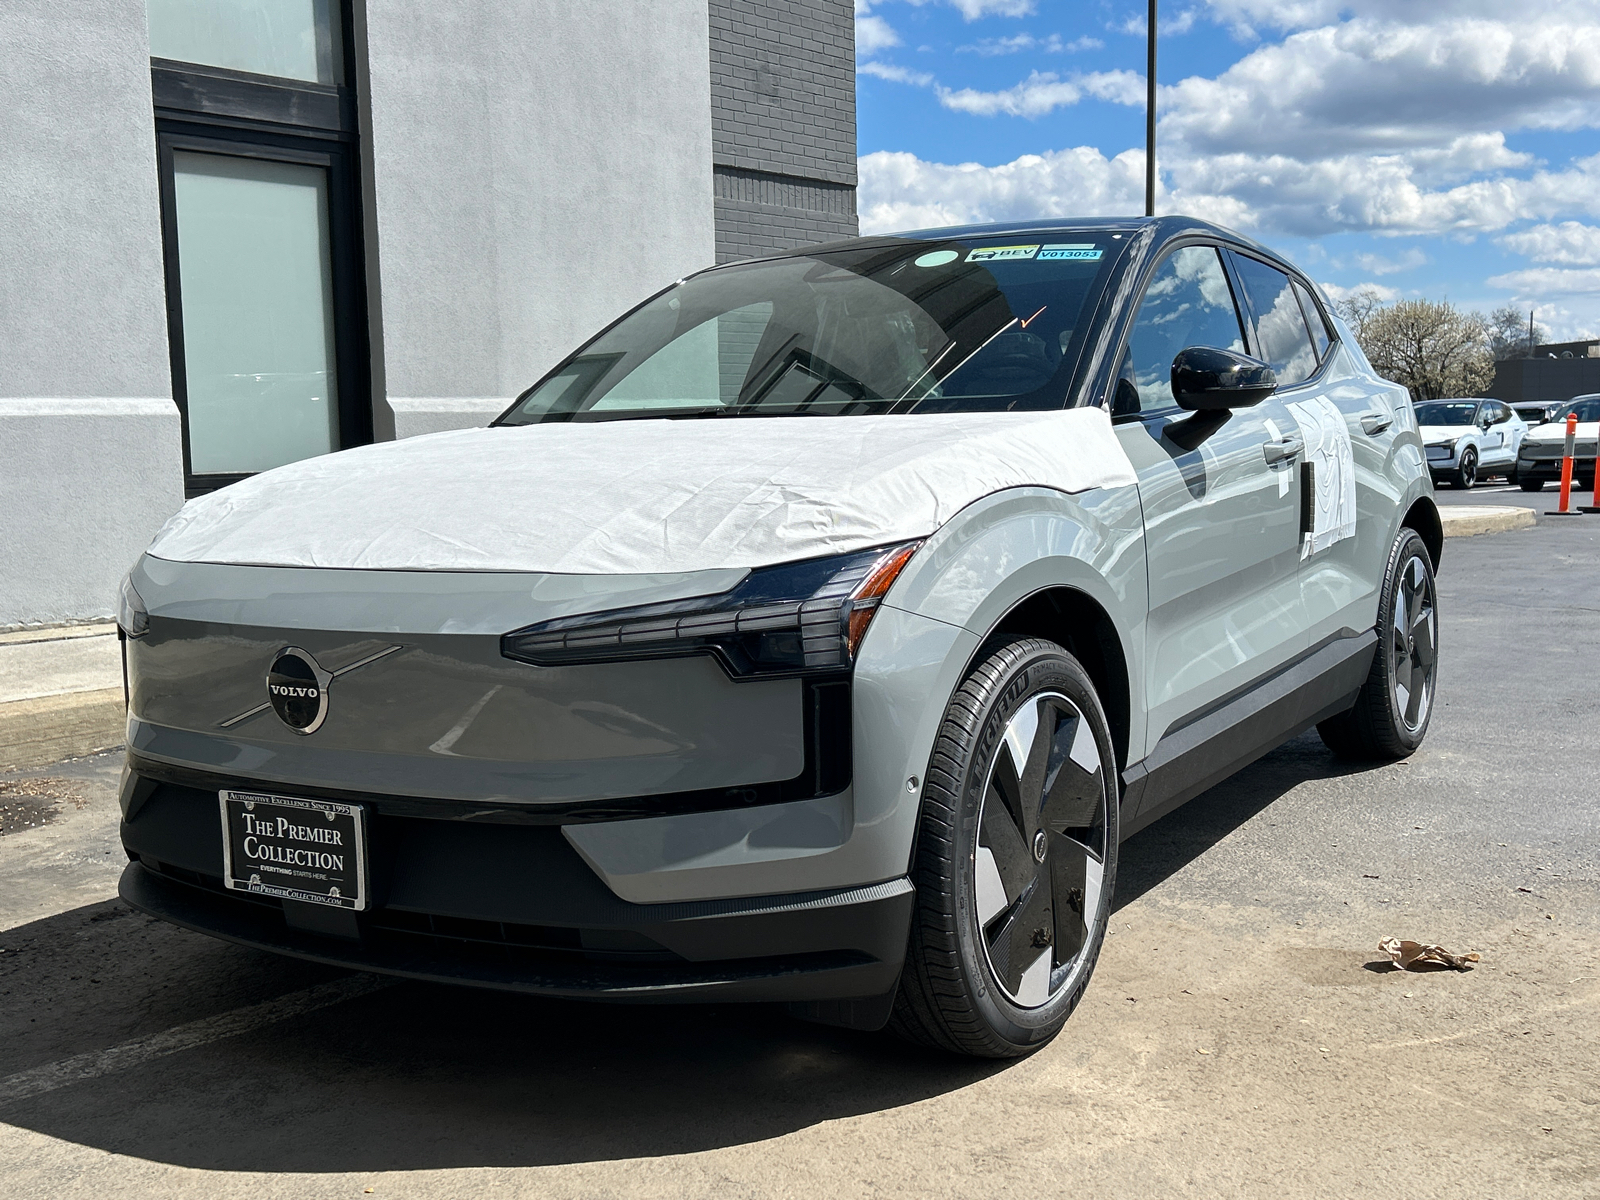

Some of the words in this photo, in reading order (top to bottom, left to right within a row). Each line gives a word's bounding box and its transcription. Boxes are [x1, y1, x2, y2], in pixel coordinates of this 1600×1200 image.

[270, 684, 318, 698] VOLVO
[974, 670, 1029, 779] MICHELIN
[332, 804, 350, 814] 1995
[260, 864, 293, 876] EVERYTHING
[293, 870, 312, 879] STARTS
